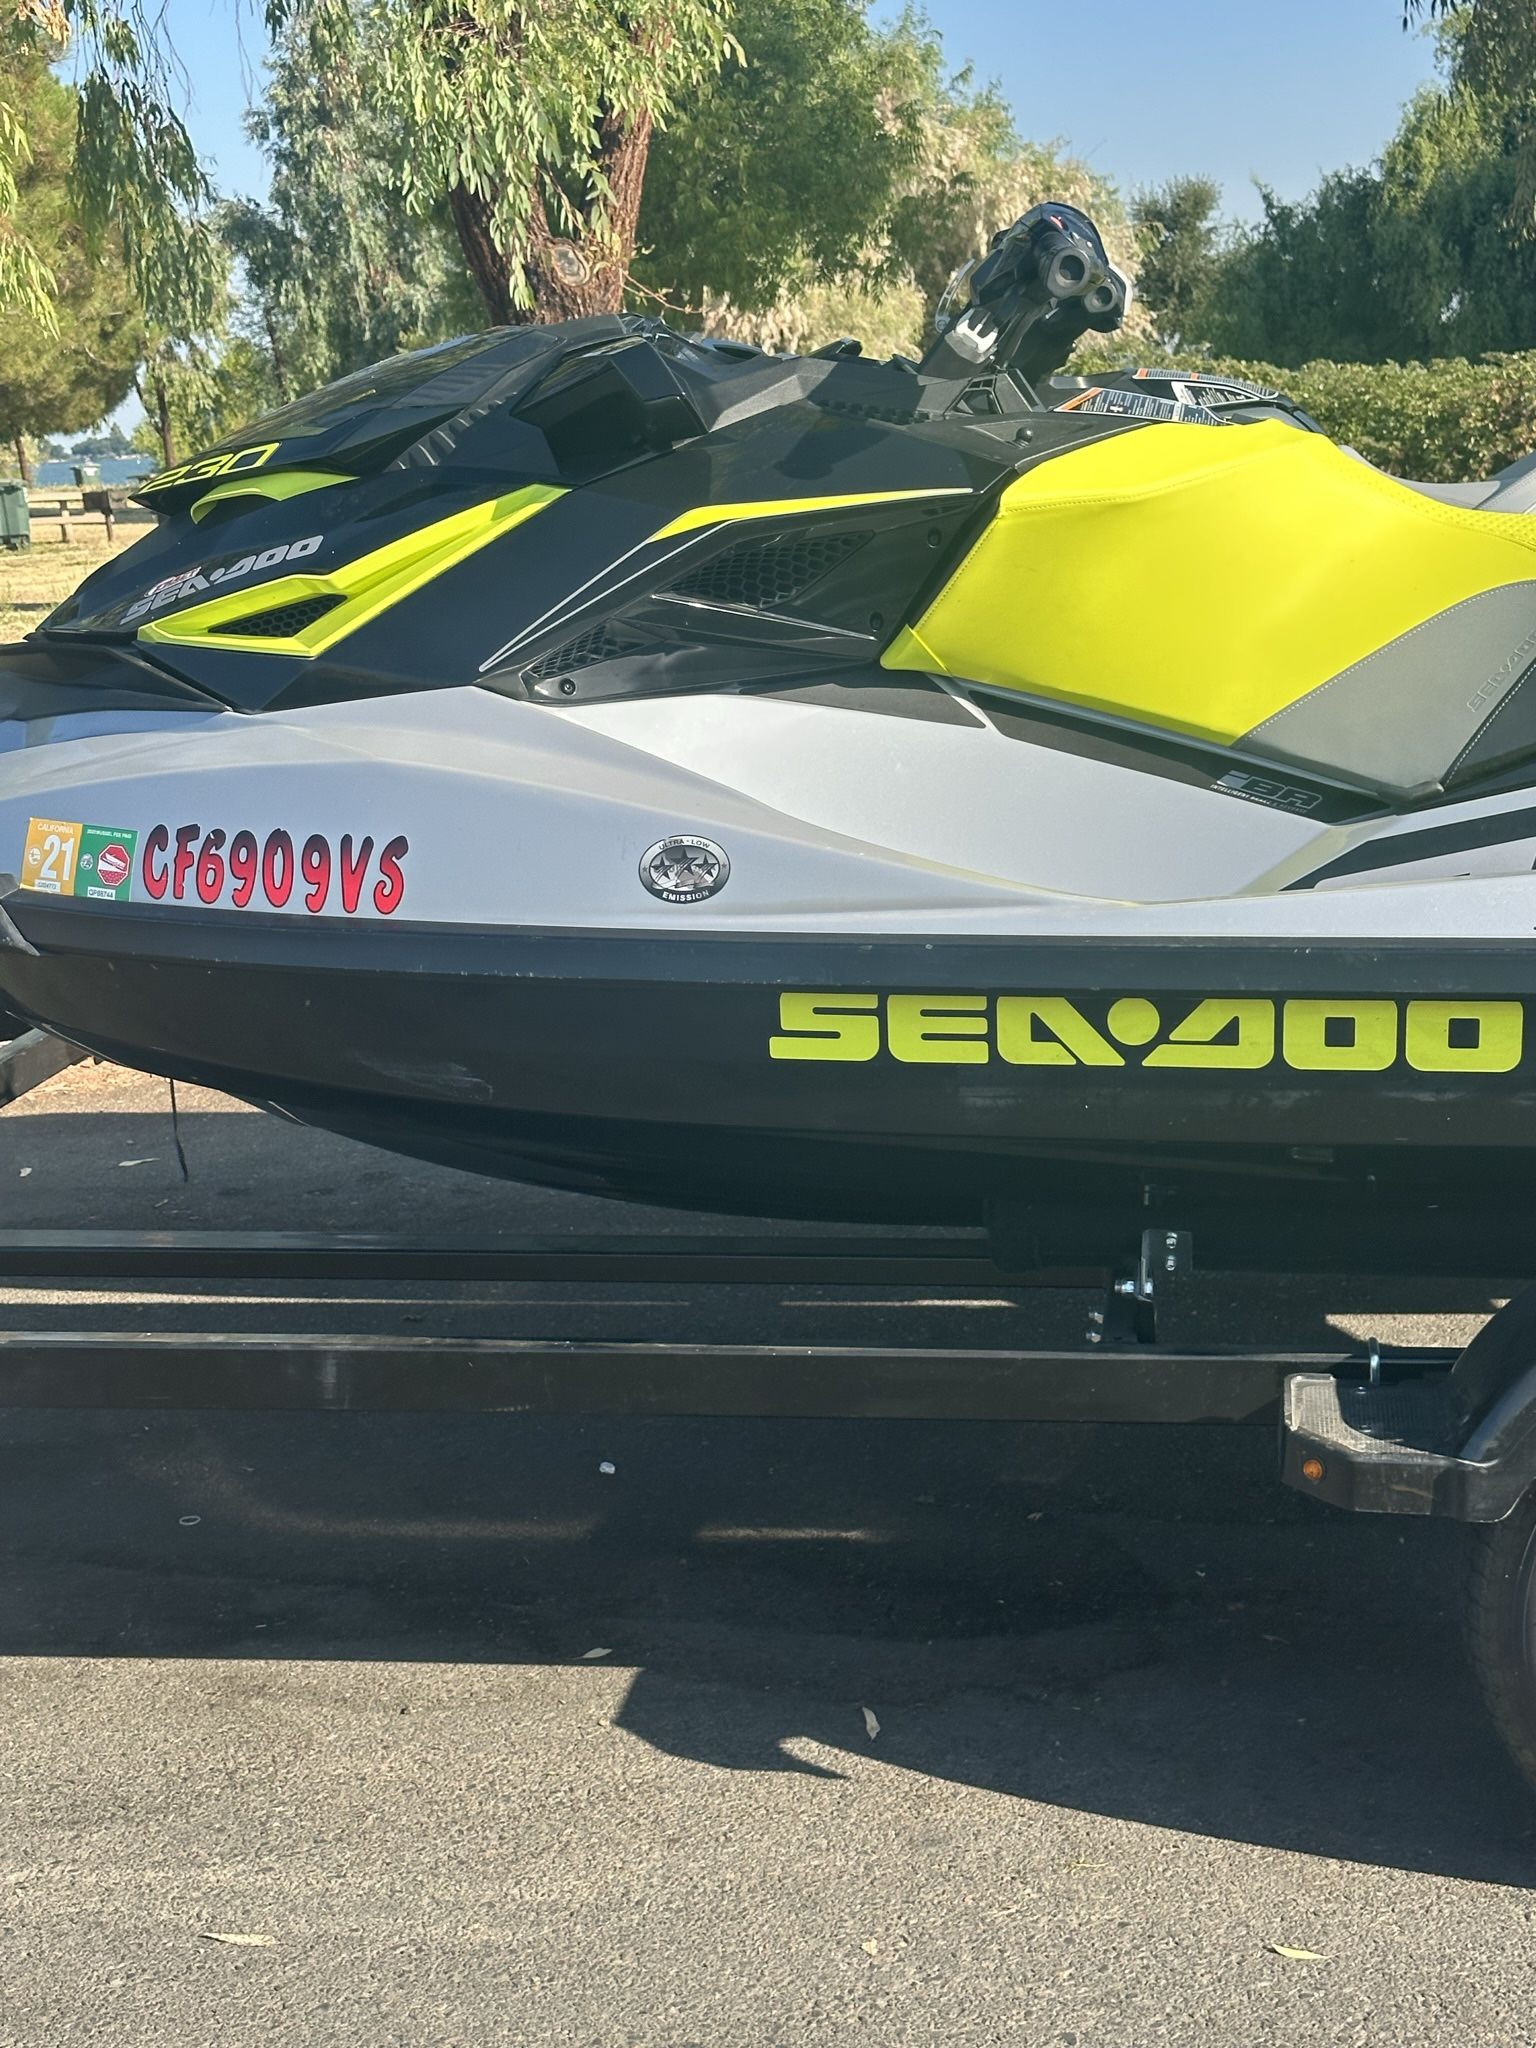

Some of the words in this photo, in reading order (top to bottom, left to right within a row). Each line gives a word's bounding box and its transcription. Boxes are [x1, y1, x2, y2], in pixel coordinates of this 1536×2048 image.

[138, 441, 282, 494] 230
[37, 823, 74, 834] CALIFORNIA
[40, 834, 75, 881] 21
[143, 823, 409, 914] CF6909VS
[662, 890, 710, 902] EMISSION
